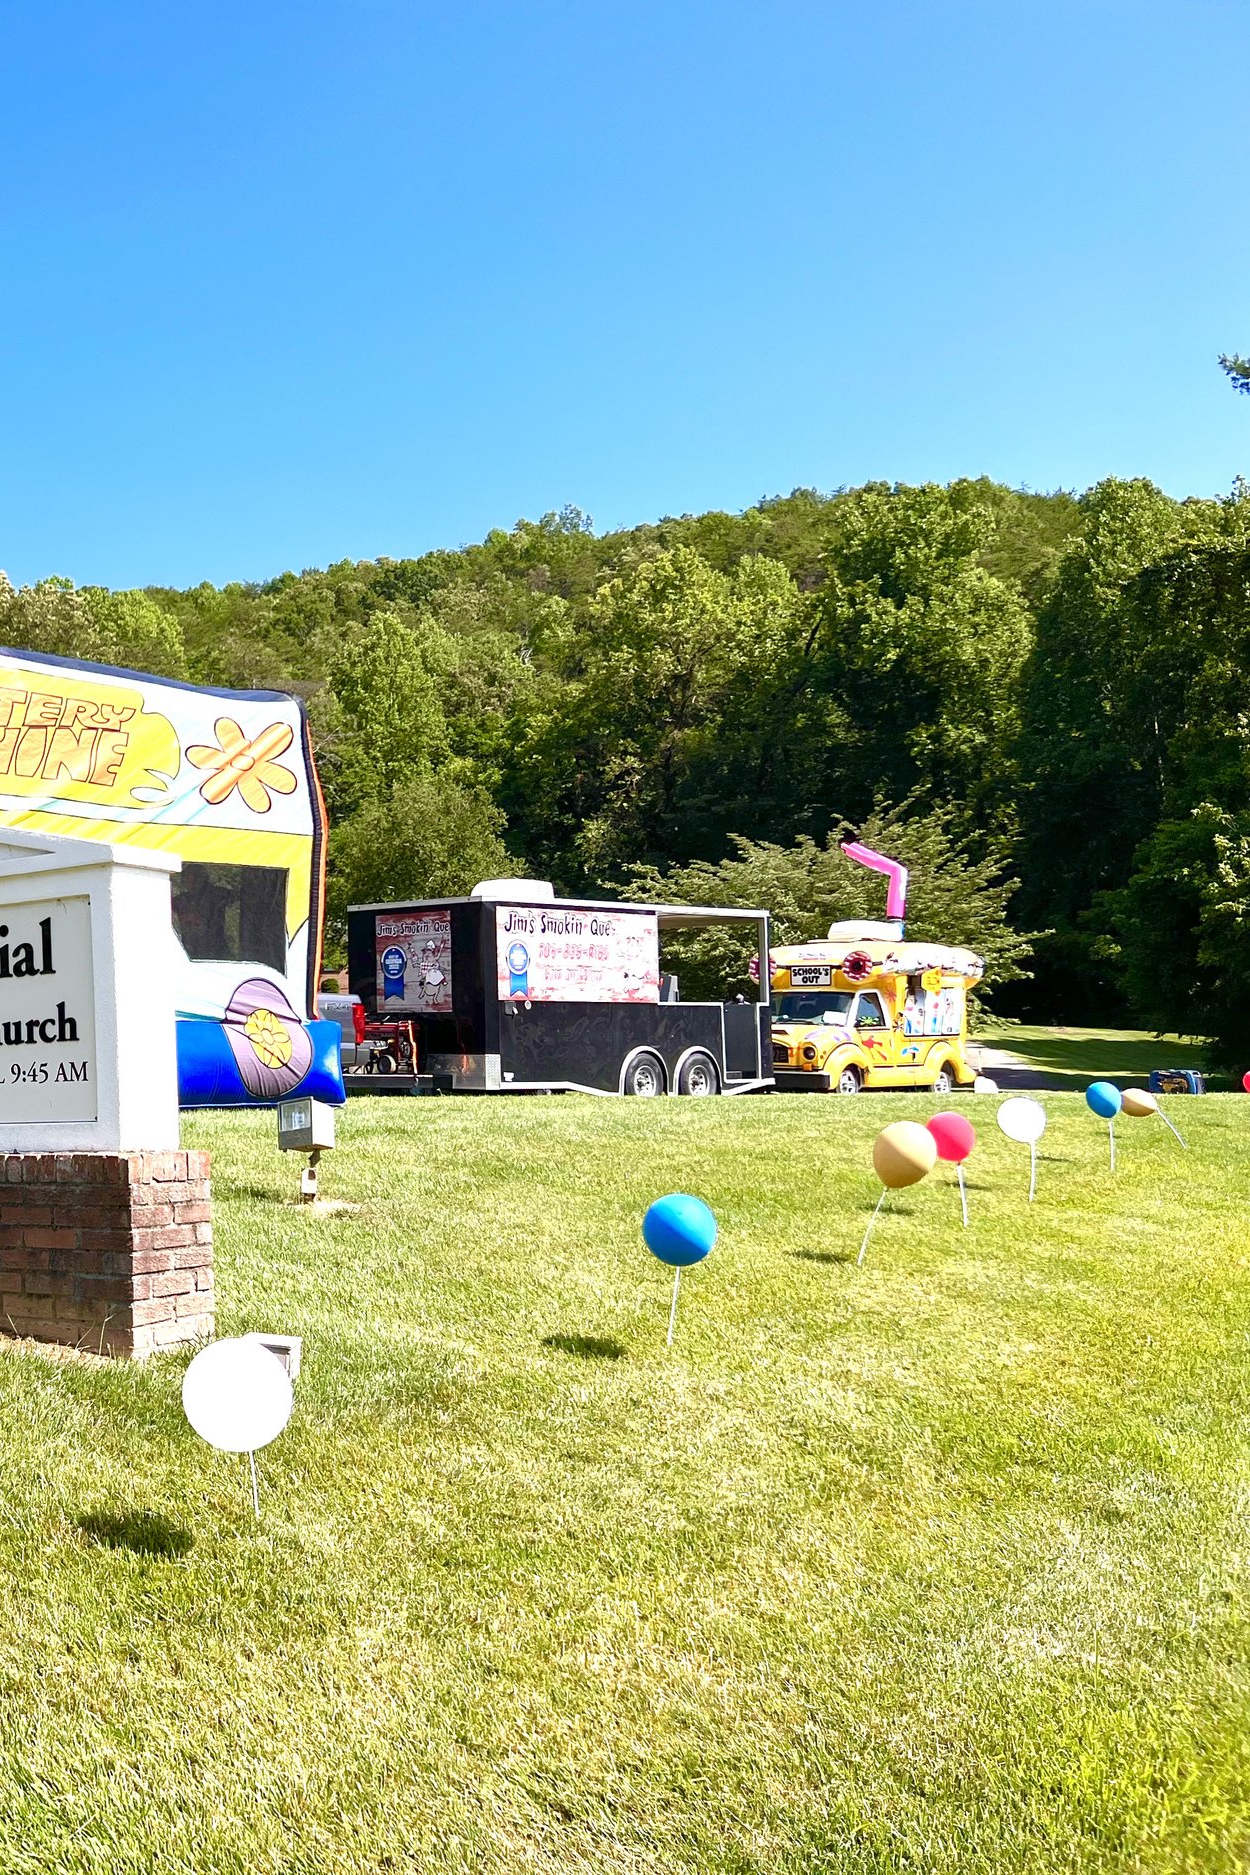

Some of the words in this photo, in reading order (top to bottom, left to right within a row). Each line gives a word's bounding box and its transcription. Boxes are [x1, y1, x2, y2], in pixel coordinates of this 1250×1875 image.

[434, 921, 450, 932] Que
[792, 967, 829, 977] SCHOOL'S
[802, 976, 820, 984] OUT
[10, 1061, 49, 1085] 9:45
[54, 1061, 89, 1083] AM
